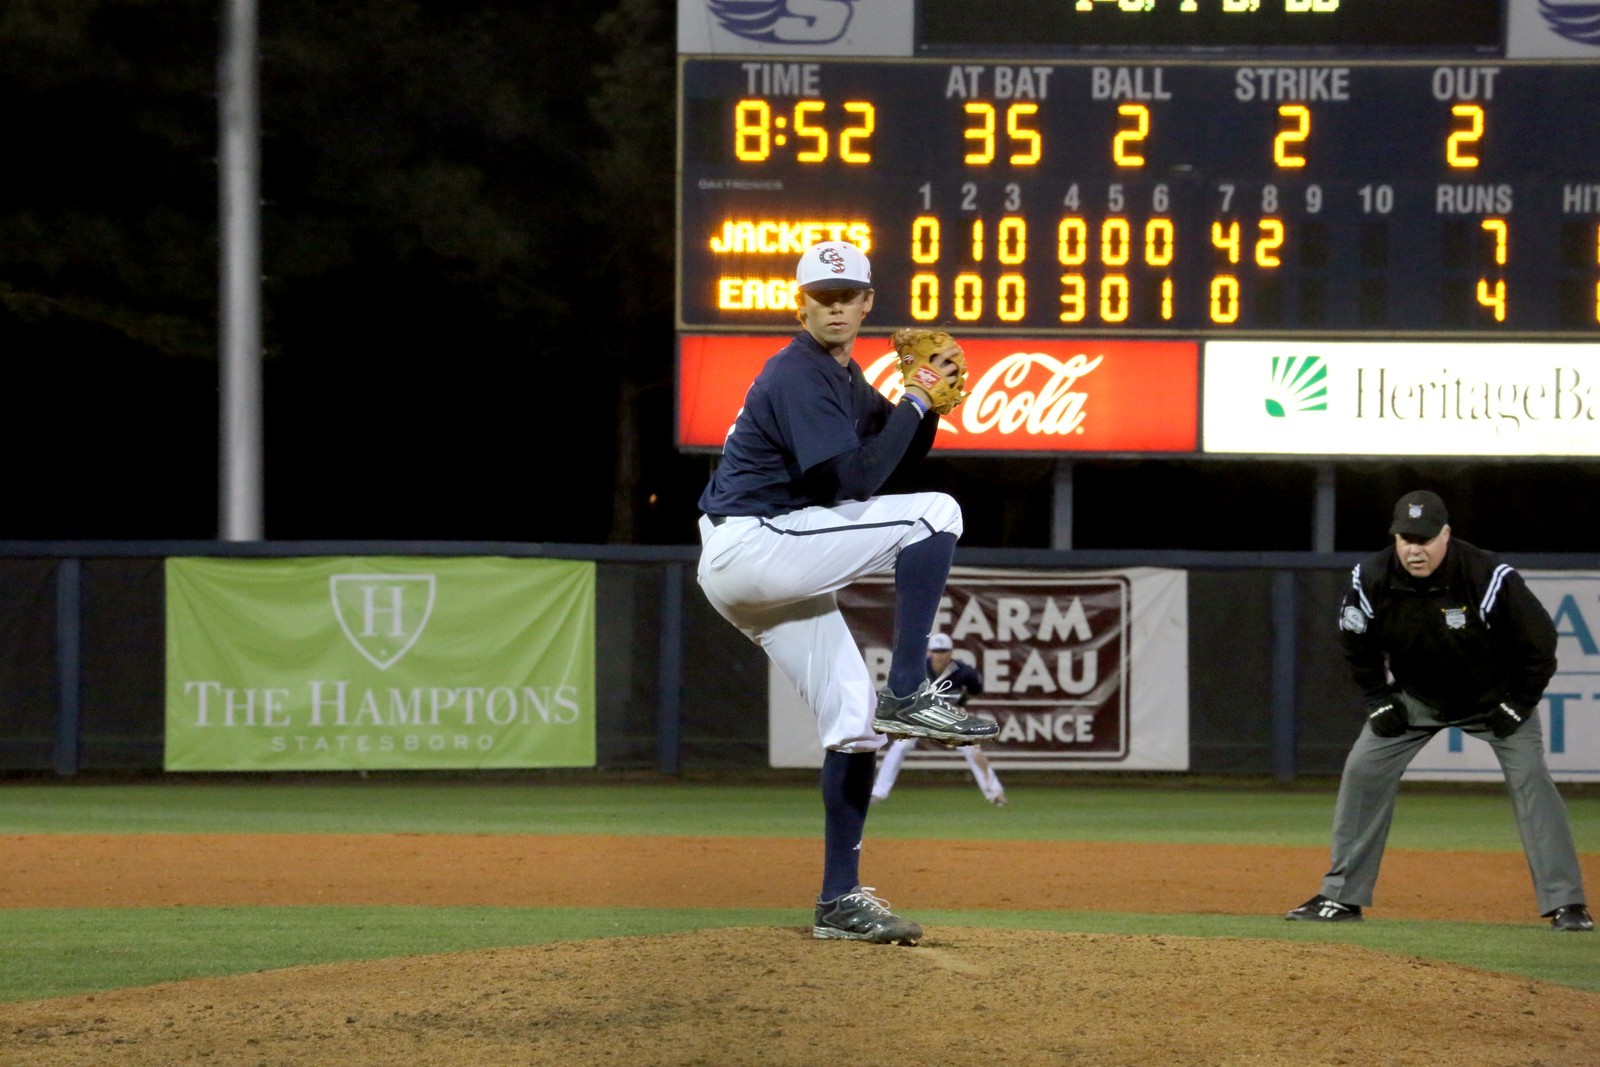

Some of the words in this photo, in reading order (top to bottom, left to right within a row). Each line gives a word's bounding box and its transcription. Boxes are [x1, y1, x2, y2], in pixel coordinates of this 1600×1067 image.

[742, 63, 821, 97] TIME
[946, 66, 984, 98] AT
[994, 67, 1053, 99] BAT
[1092, 67, 1171, 100] BALL
[1235, 67, 1350, 100] STRIKE
[1432, 67, 1499, 100] OUT
[734, 99, 875, 163] 8:52
[963, 102, 1042, 166] 35
[1113, 104, 1150, 167] 2
[1274, 104, 1311, 168] 2
[1446, 104, 1485, 168] 2
[919, 183, 932, 210] 1
[961, 183, 978, 210] 2
[1004, 183, 1021, 211] 3
[1063, 183, 1080, 211] 4
[1108, 184, 1124, 212] 5
[1152, 184, 1169, 212] 6
[1218, 184, 1235, 212] 7
[1262, 185, 1278, 213] 8
[1305, 185, 1322, 213] 9
[1359, 185, 1395, 213] 10
[1436, 185, 1514, 213] RUNS
[709, 220, 871, 254] JACKETS
[912, 216, 940, 264] 0
[973, 218, 984, 262] 1
[998, 216, 1027, 265] 0
[1058, 217, 1087, 266] 0
[1101, 217, 1130, 266] 0
[1145, 218, 1174, 266] 0
[1211, 220, 1240, 264] 4
[1255, 218, 1284, 267] 2
[1481, 219, 1508, 265] 7
[911, 273, 939, 321] 0
[954, 273, 983, 321] 0
[997, 273, 1026, 322] 0
[1059, 274, 1086, 322] 3
[1100, 274, 1129, 322] 0
[1162, 277, 1173, 320] 1
[1210, 275, 1239, 323] 0
[1476, 278, 1506, 322] 4
[358, 585, 407, 638] H
[929, 595, 1094, 643] FARM
[865, 646, 1099, 696] BEAU
[183, 680, 292, 728] THE
[307, 680, 580, 728] HAMPTONS
[270, 734, 495, 753] STATESBORO
